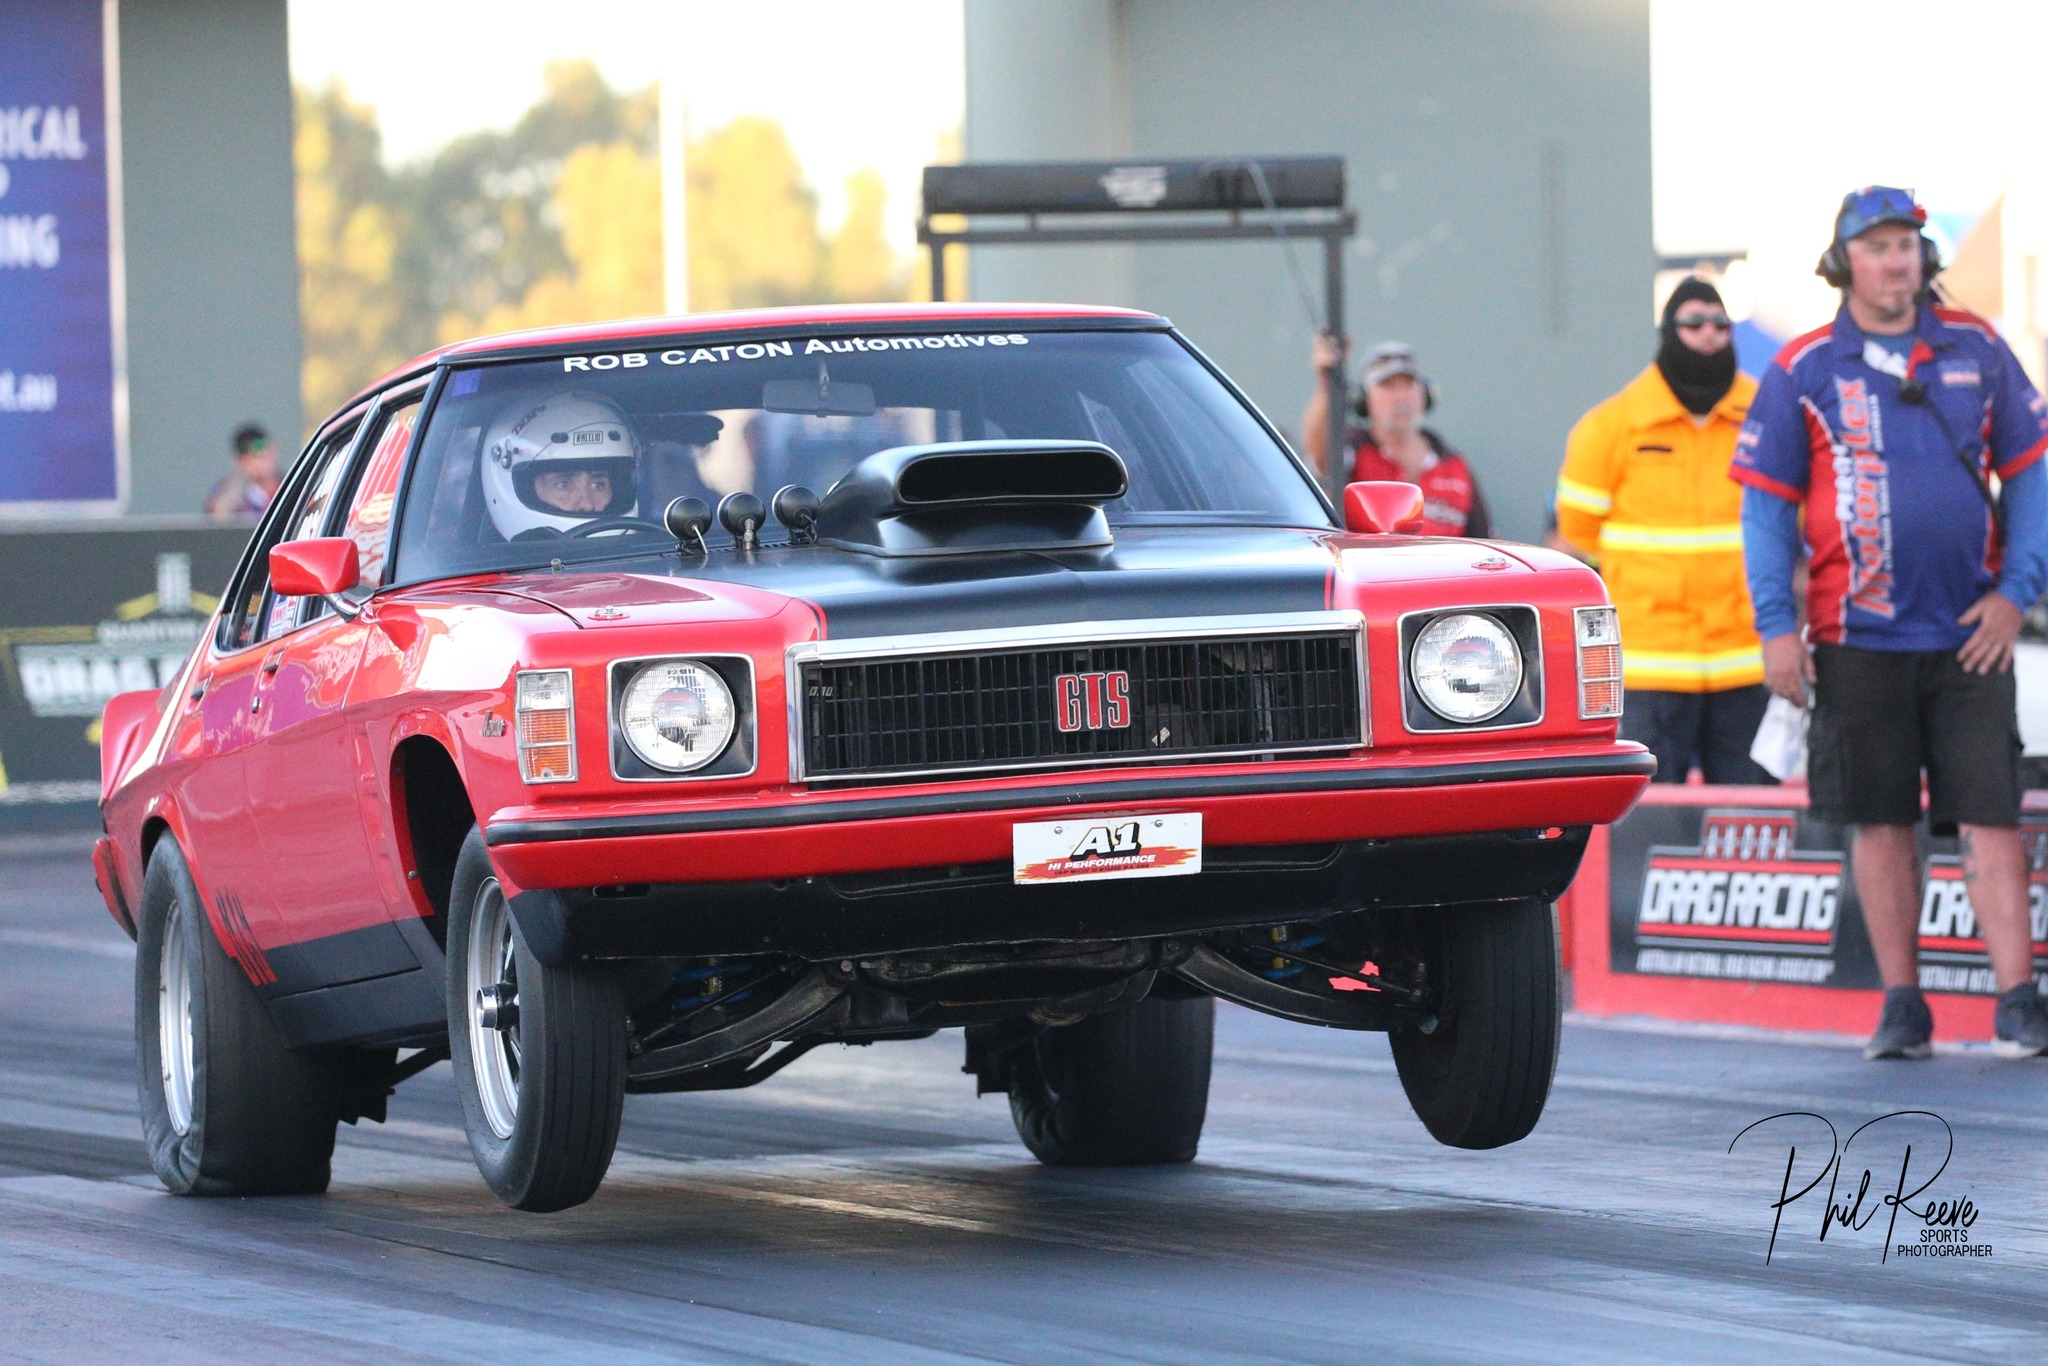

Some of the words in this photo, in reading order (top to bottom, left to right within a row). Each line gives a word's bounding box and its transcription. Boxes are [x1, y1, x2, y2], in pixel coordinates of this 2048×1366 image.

[564, 353, 648, 372] ROB
[660, 341, 793, 365] CATON
[804, 333, 1029, 354] Automotives
[1833, 375, 1896, 619] Motorplex
[1056, 671, 1130, 732] GTS
[1047, 862, 1062, 871] HI
[1064, 854, 1156, 869] PERFORMANCE
[1069, 821, 1142, 861] A1
[1640, 868, 1730, 926] DRAG
[1723, 871, 1841, 932] RACING
